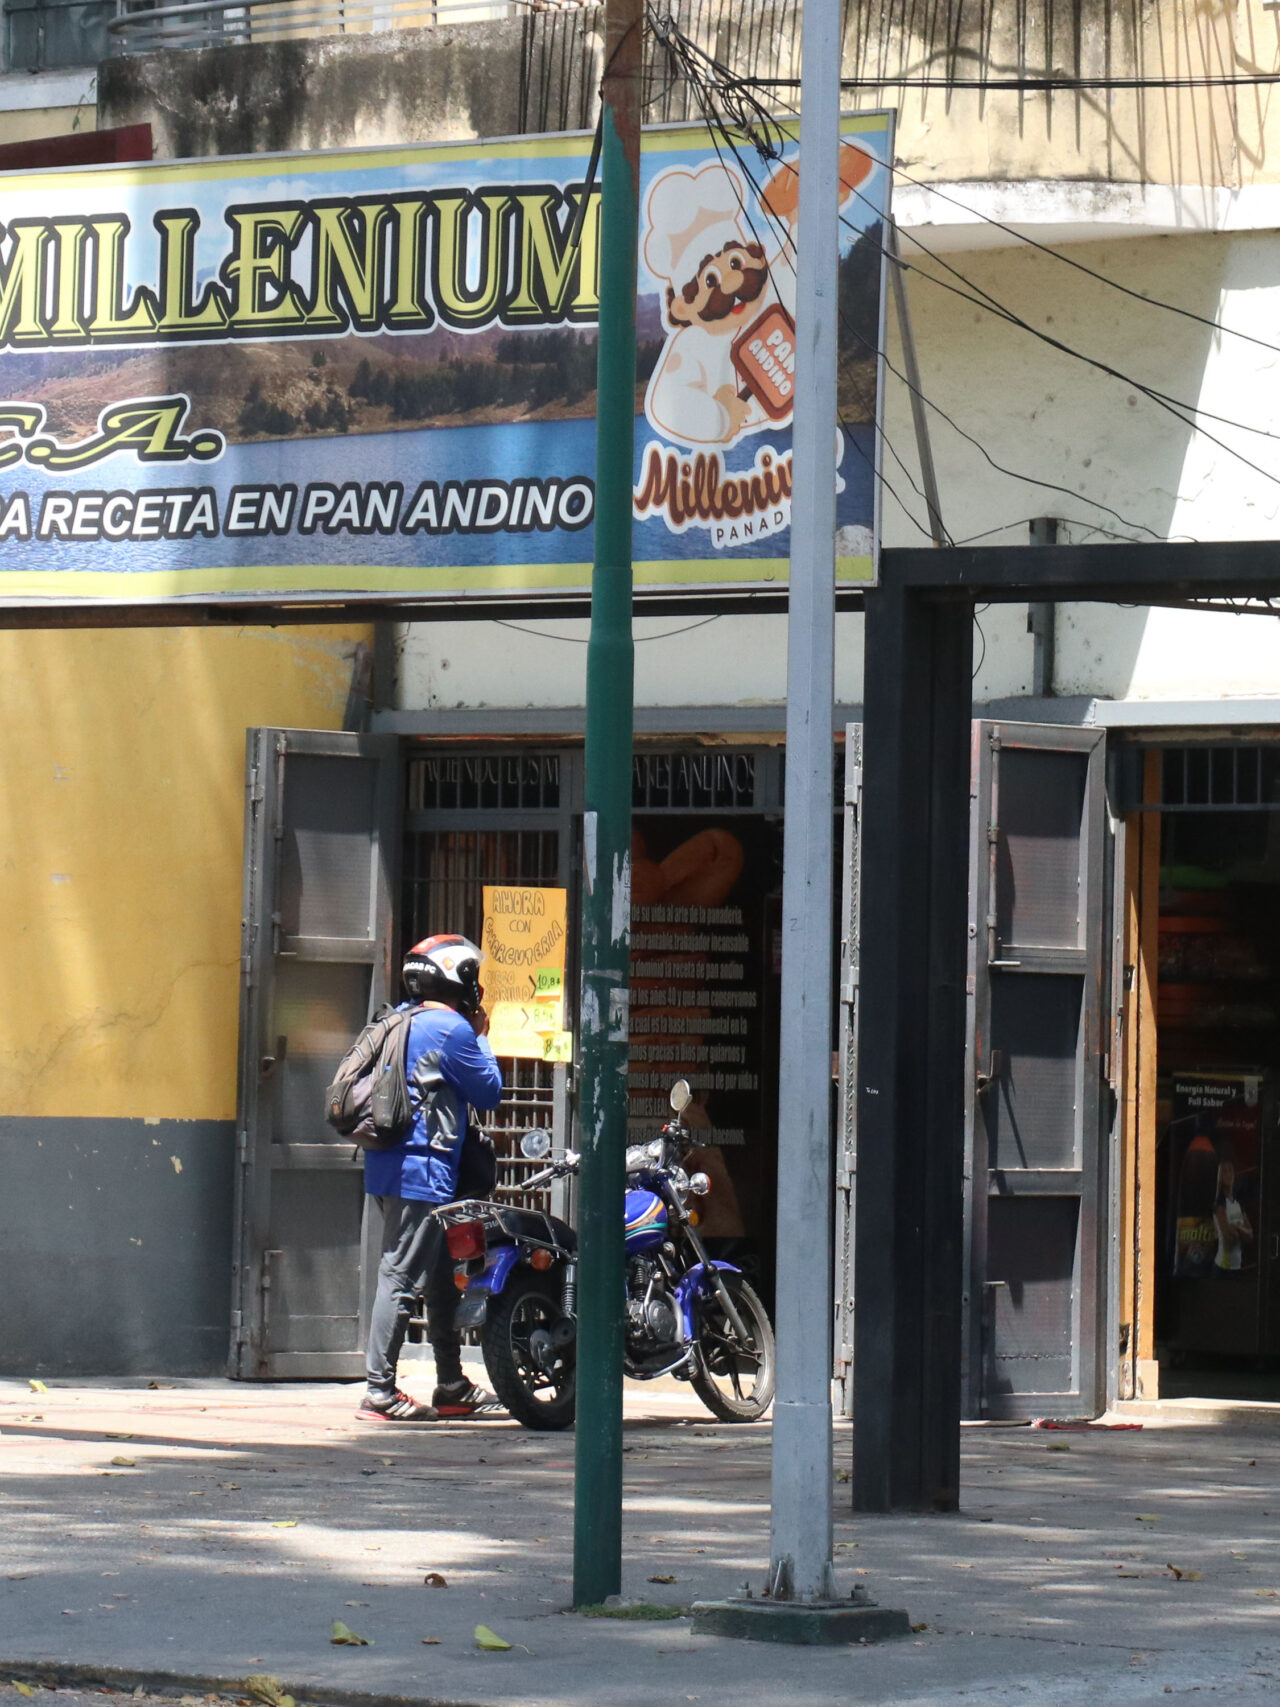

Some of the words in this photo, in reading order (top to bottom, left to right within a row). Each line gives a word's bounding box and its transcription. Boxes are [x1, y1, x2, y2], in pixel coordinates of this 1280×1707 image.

[748, 339, 792, 396] ANDINO
[766, 328, 794, 374] PAN
[634, 448, 793, 527] Milleniu
[39, 491, 216, 538] RECETA
[227, 487, 291, 532] EN
[303, 485, 398, 531] PAN
[404, 481, 595, 529] ANDINO
[716, 510, 784, 542] PANAD
[492, 890, 546, 917] AHORA
[484, 916, 565, 966] CHARCUTERIA
[509, 919, 532, 934] CON
[1188, 1096, 1202, 1107] Full
[1204, 1085, 1231, 1096] Natural
